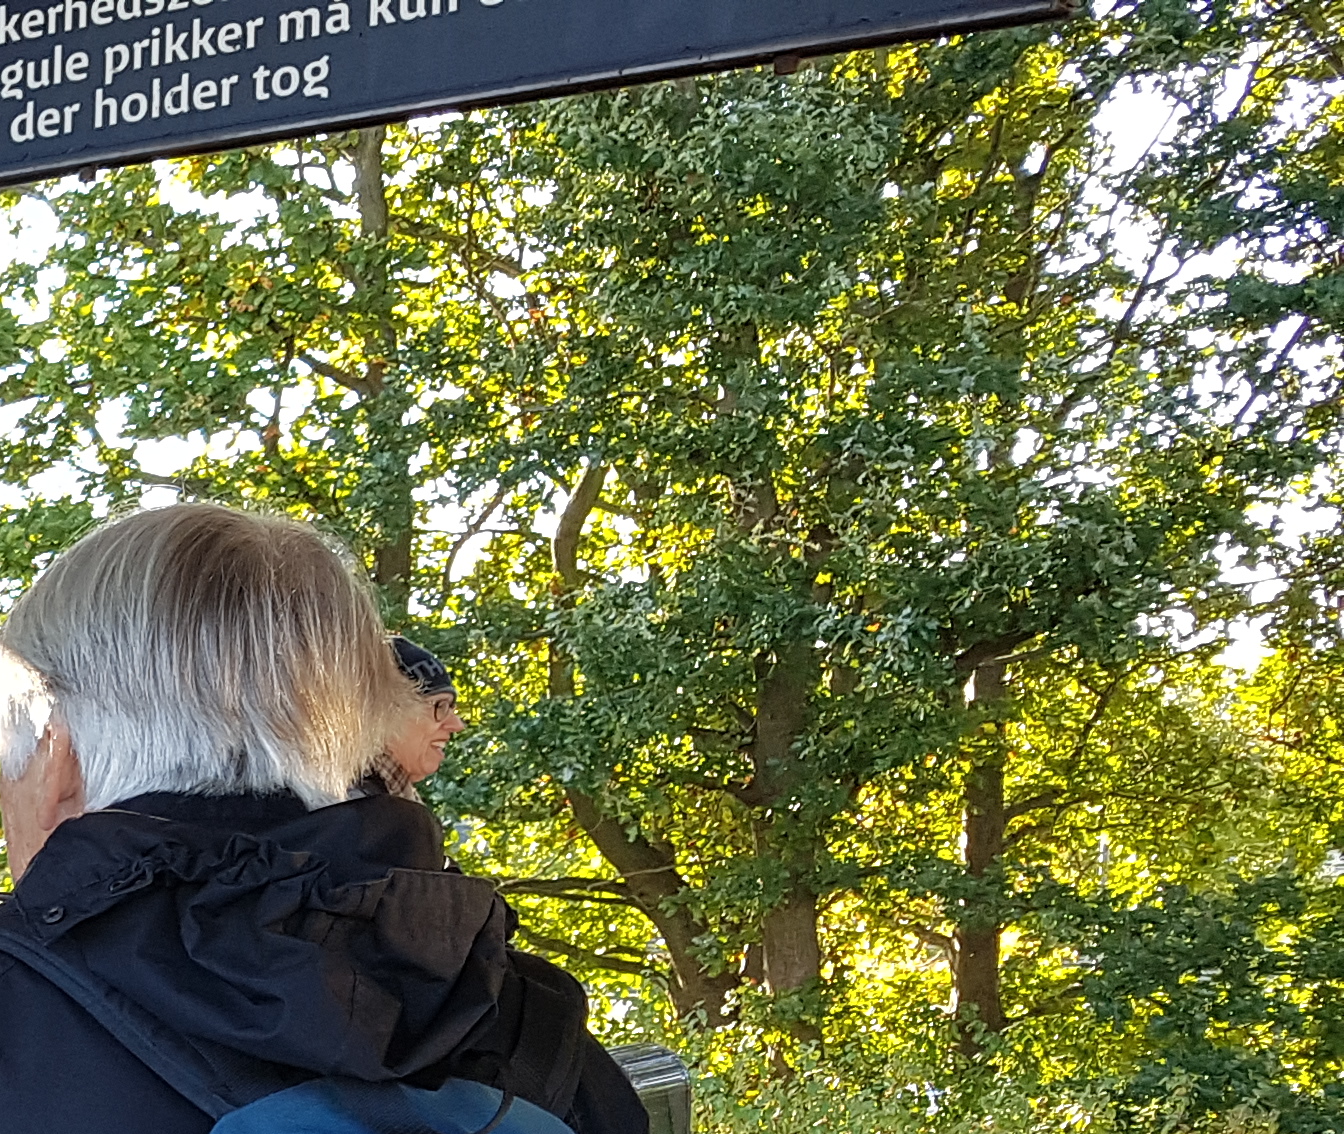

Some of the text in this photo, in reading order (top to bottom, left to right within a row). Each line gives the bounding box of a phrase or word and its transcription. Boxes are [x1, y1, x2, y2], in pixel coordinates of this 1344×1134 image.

[0, 45, 89, 100] gule
[105, 17, 264, 85] prikker
[369, 0, 458, 27] kun
[10, 101, 81, 142] der
[93, 73, 239, 128] holder
[252, 55, 330, 100] tog
